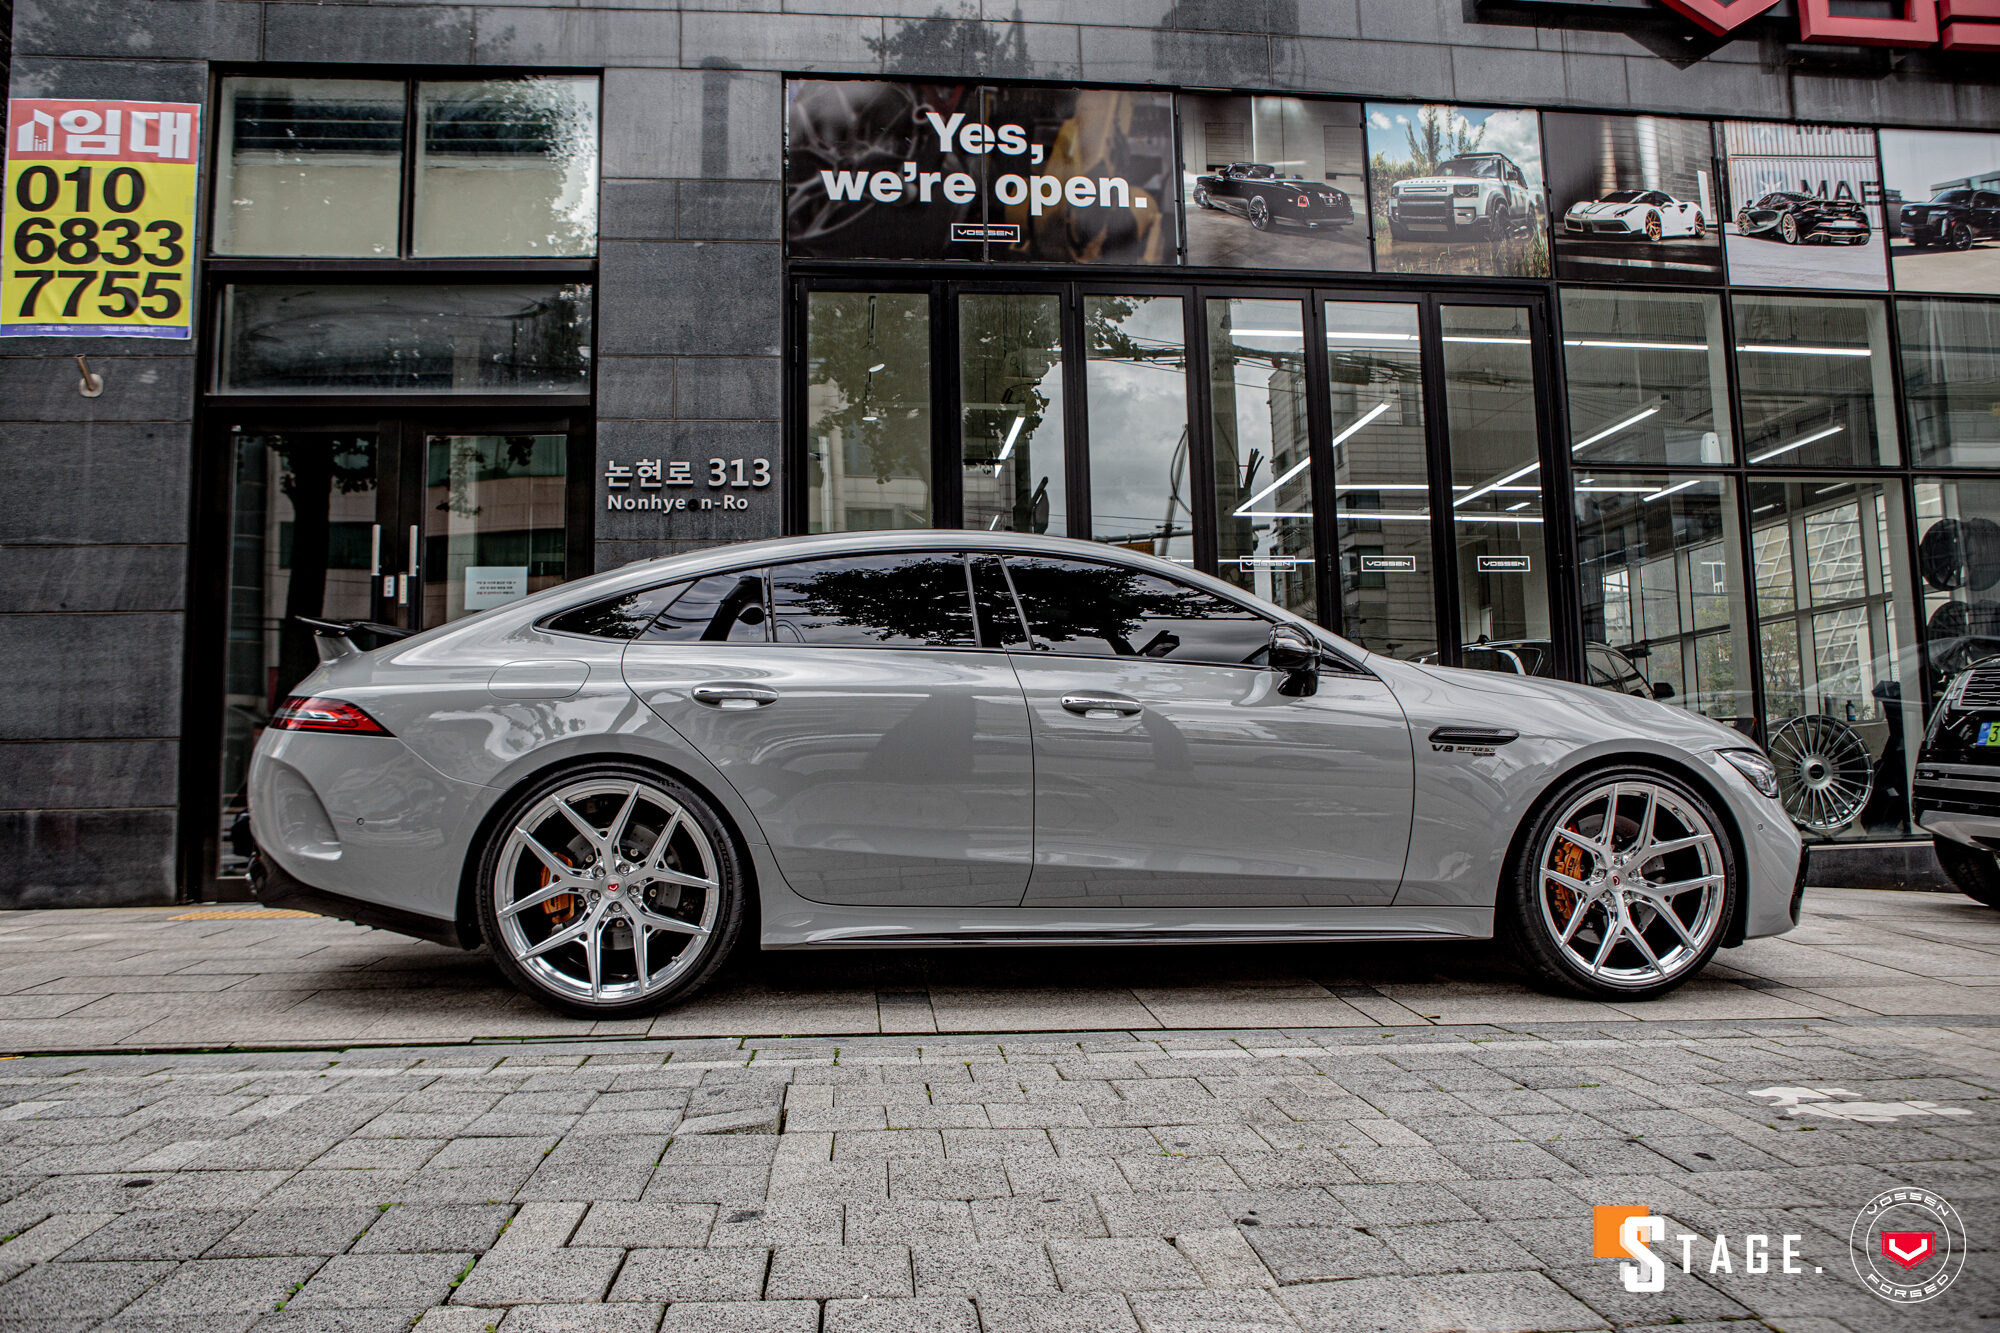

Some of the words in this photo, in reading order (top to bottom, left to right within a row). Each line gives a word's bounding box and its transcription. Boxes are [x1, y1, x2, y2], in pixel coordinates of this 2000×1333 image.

[59, 109, 192, 159] 임대
[925, 112, 1044, 165] Yes,
[16, 165, 146, 213] 010
[820, 161, 976, 204] we're
[995, 173, 1148, 216] open.
[14, 217, 184, 267] 6833
[957, 229, 1014, 237] VOSSEN
[14, 270, 182, 319] 7755
[604, 458, 694, 488] 논현로
[708, 457, 771, 487] 313
[607, 494, 748, 514] Nonhyen-Ro
